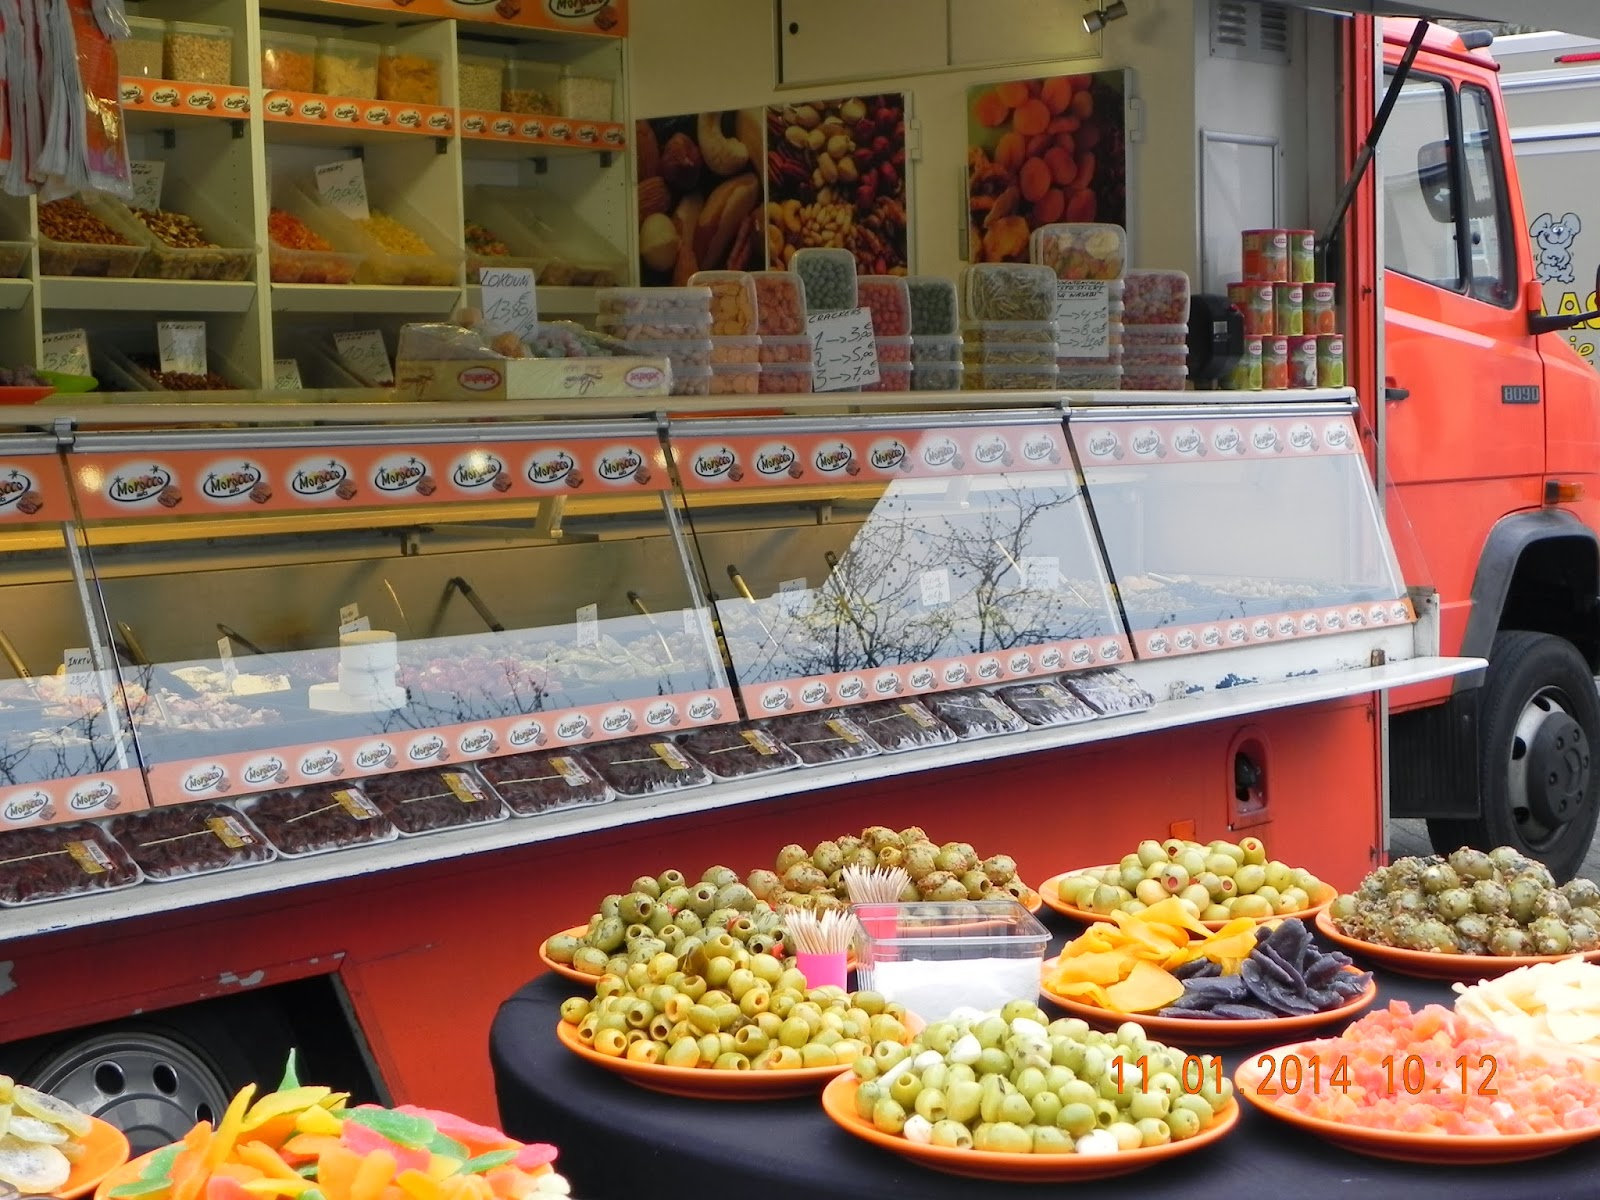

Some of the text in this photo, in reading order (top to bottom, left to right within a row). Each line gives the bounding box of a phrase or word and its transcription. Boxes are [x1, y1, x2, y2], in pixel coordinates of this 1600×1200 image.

[480, 271, 530, 287] LOKOUM
[809, 308, 862, 323] CRACKERS
[813, 331, 823, 351] 1
[814, 352, 826, 367] 2
[701, 442, 1051, 473] Morocco Morocco Morocco Morocco Morocco Morocco Morocco
[117, 457, 637, 497] Morocco Morocco Morocco Morocco Morocco Morocco Morocco
[190, 703, 713, 789] Morocco Morocco Morocco Morocco Morocco Morocco Morocco Morocco Morocco Morocco Morocco
[9, 788, 108, 817] Morocco Morocco
